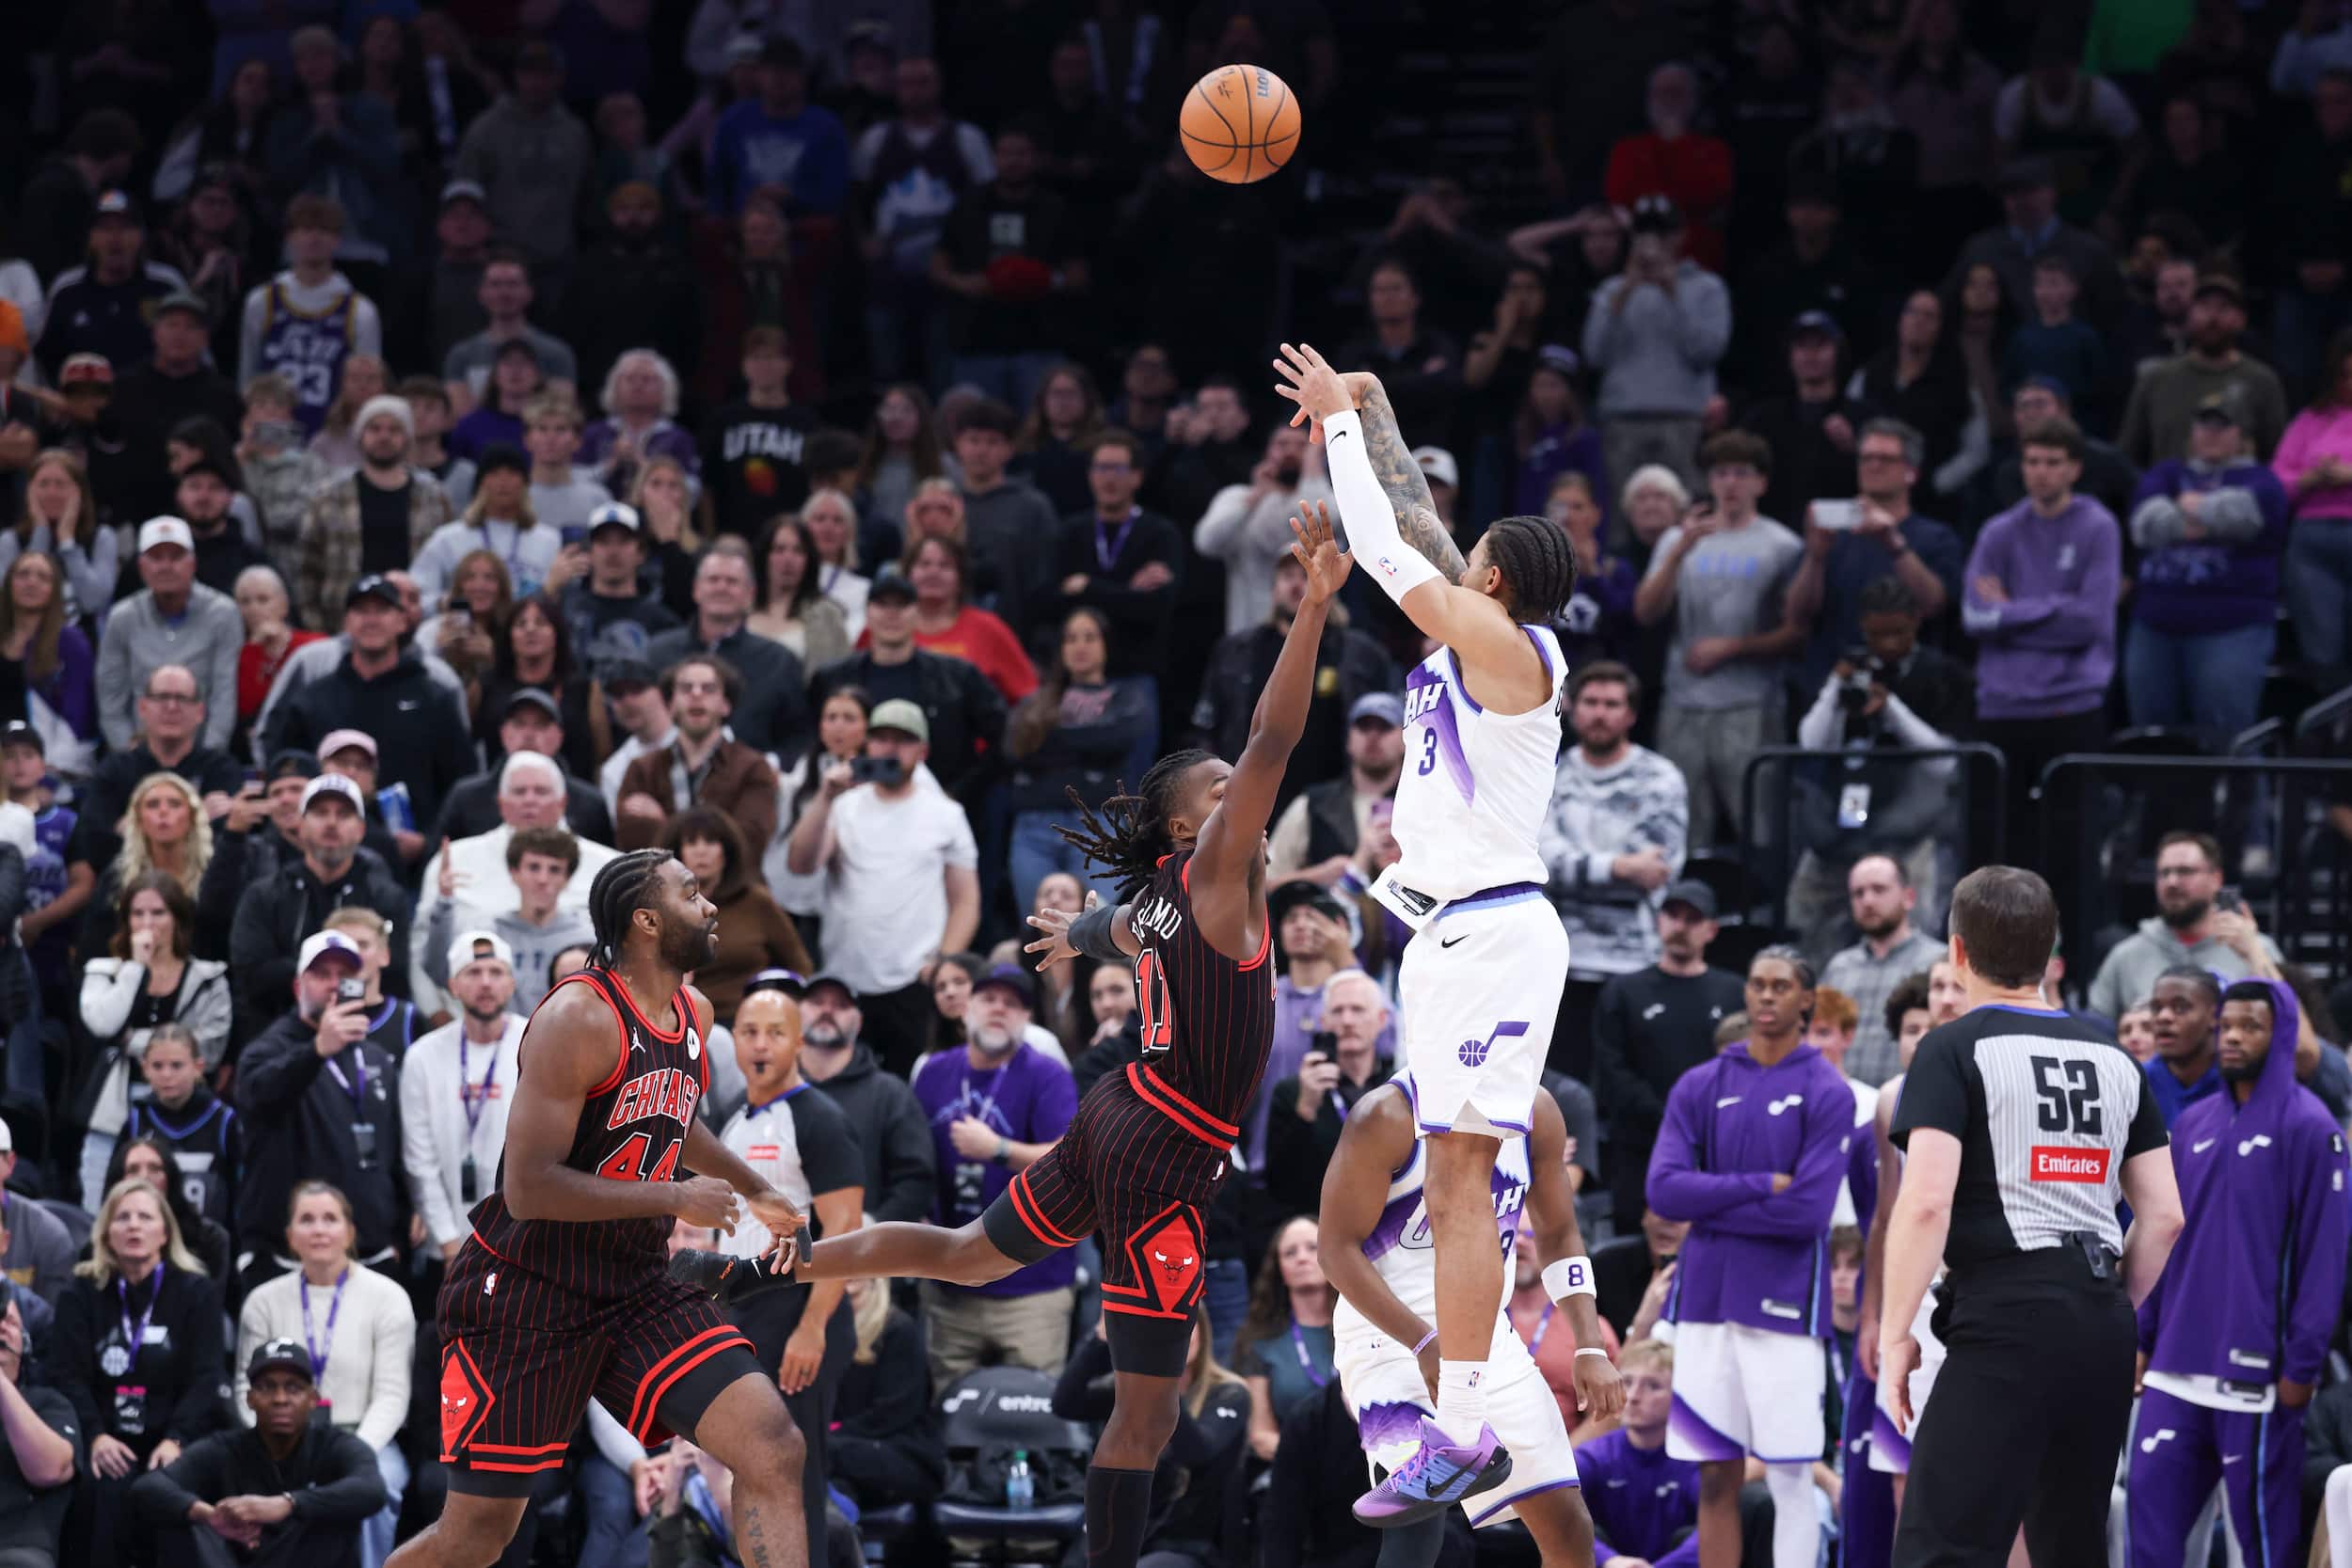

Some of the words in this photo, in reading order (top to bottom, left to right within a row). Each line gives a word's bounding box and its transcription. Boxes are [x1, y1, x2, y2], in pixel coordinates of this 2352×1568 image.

[723, 421, 806, 467] UTAH
[1418, 726, 1438, 777] 3
[2029, 1054, 2103, 1136] 52
[595, 1132, 683, 1182] 44
[2037, 1153, 2101, 1175] Emirates
[1567, 1263, 1585, 1288] 8
